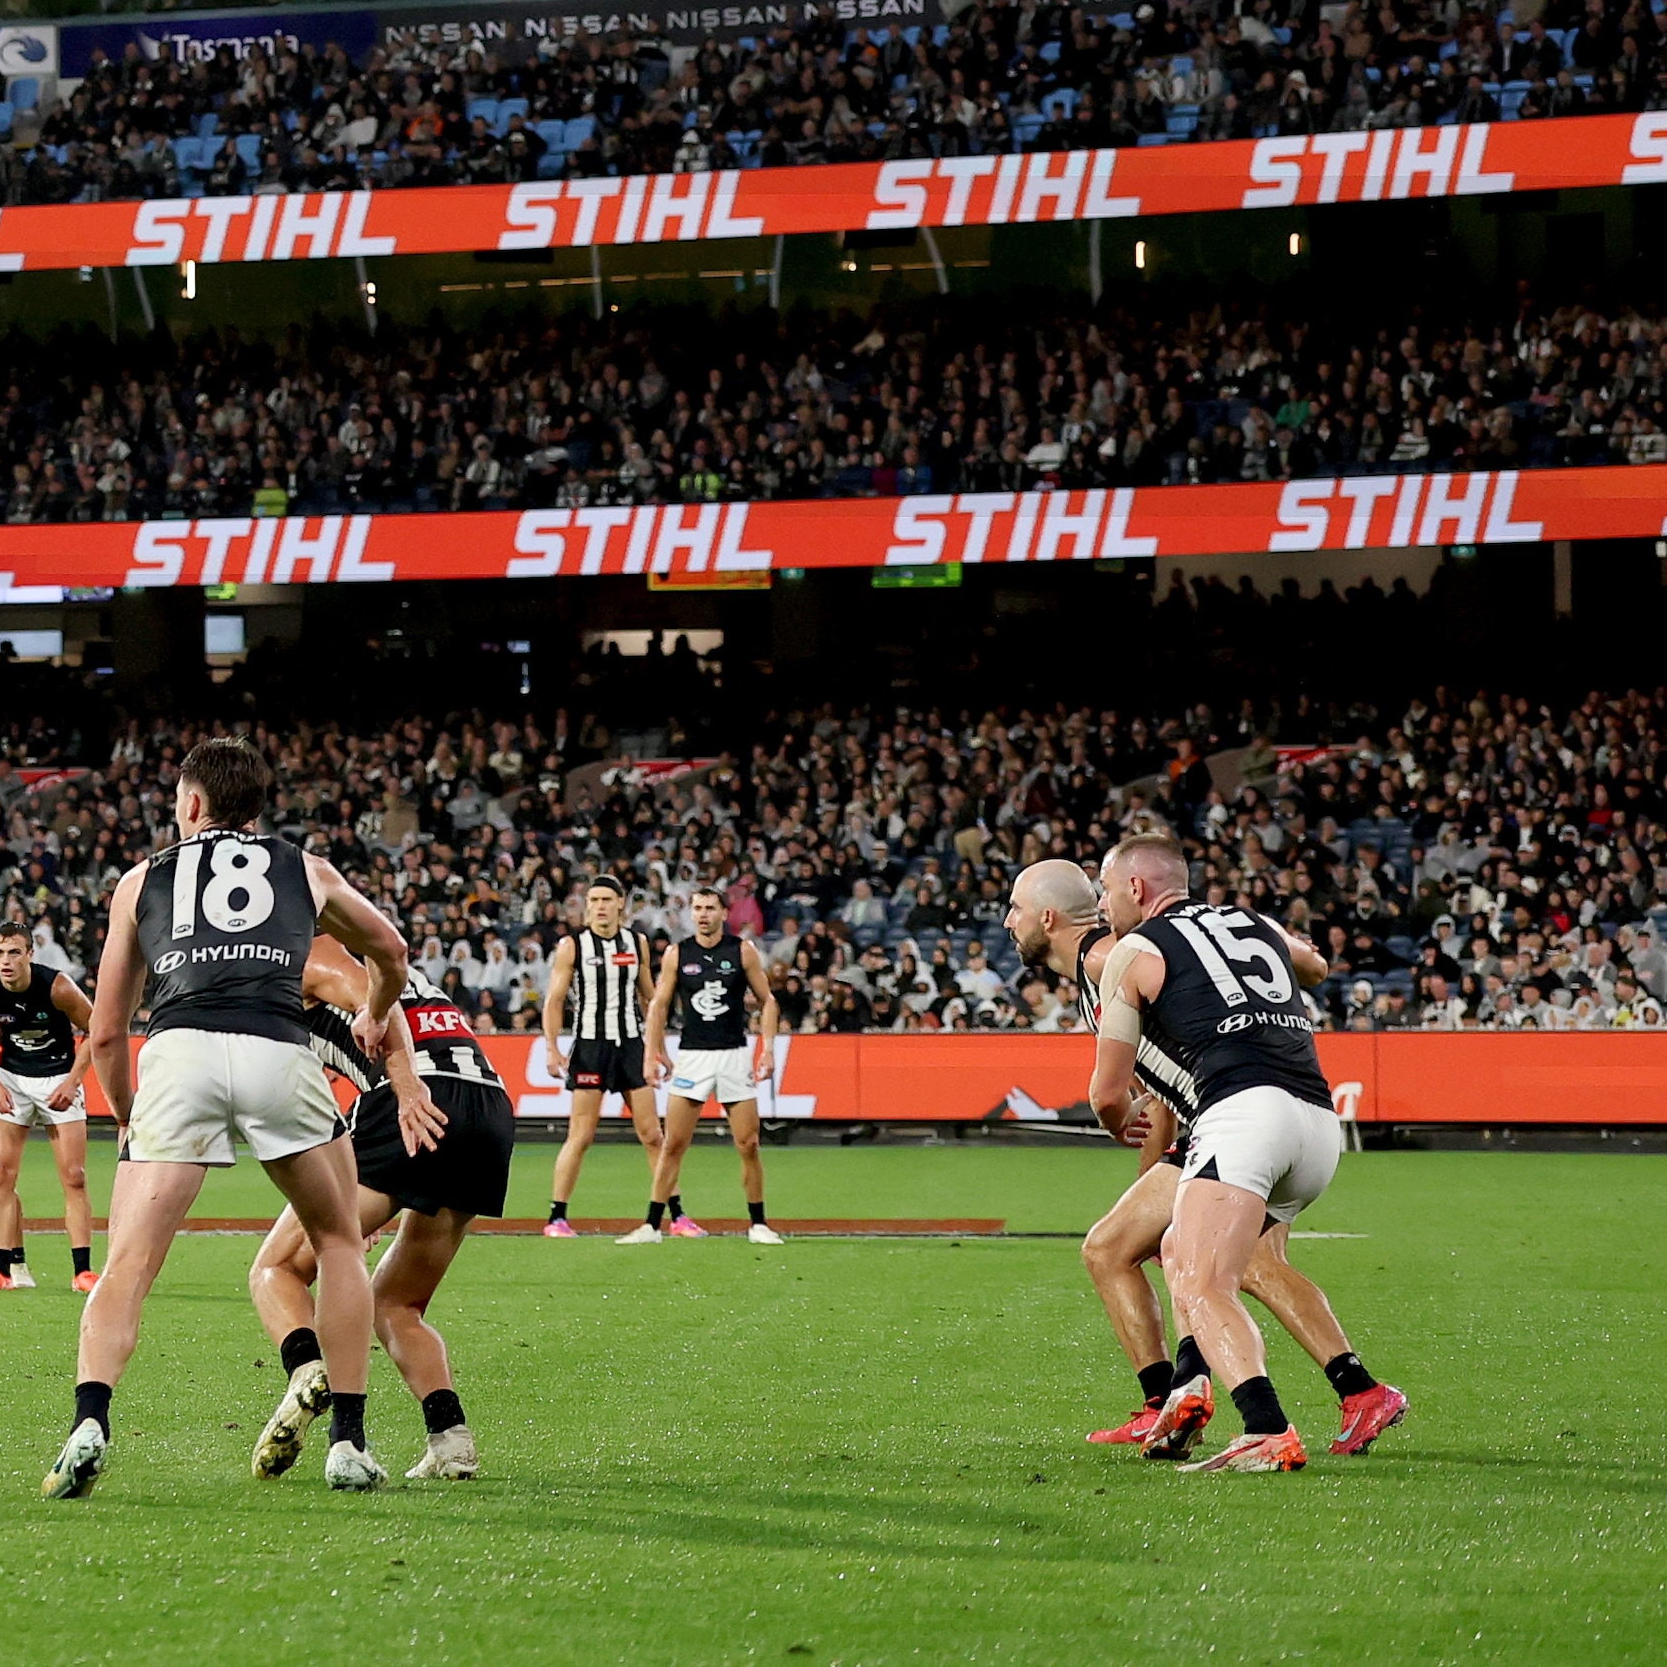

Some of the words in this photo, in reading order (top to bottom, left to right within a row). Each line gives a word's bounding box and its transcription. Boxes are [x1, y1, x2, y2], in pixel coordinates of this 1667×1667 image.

[524, 12, 649, 38] NSSAN
[666, 4, 787, 30] NISSAN
[126, 190, 396, 265] STIHL
[499, 171, 763, 249] STIHL
[867, 149, 1139, 229] STIHL
[1243, 124, 1513, 207] STIHL
[126, 516, 394, 587] STIHL
[507, 503, 772, 577] STIHL
[886, 489, 1157, 565] STIHL
[1269, 471, 1542, 551] STIHL
[172, 838, 275, 940] 18
[192, 944, 291, 967] HYUNDAI
[1169, 911, 1293, 1008] 15
